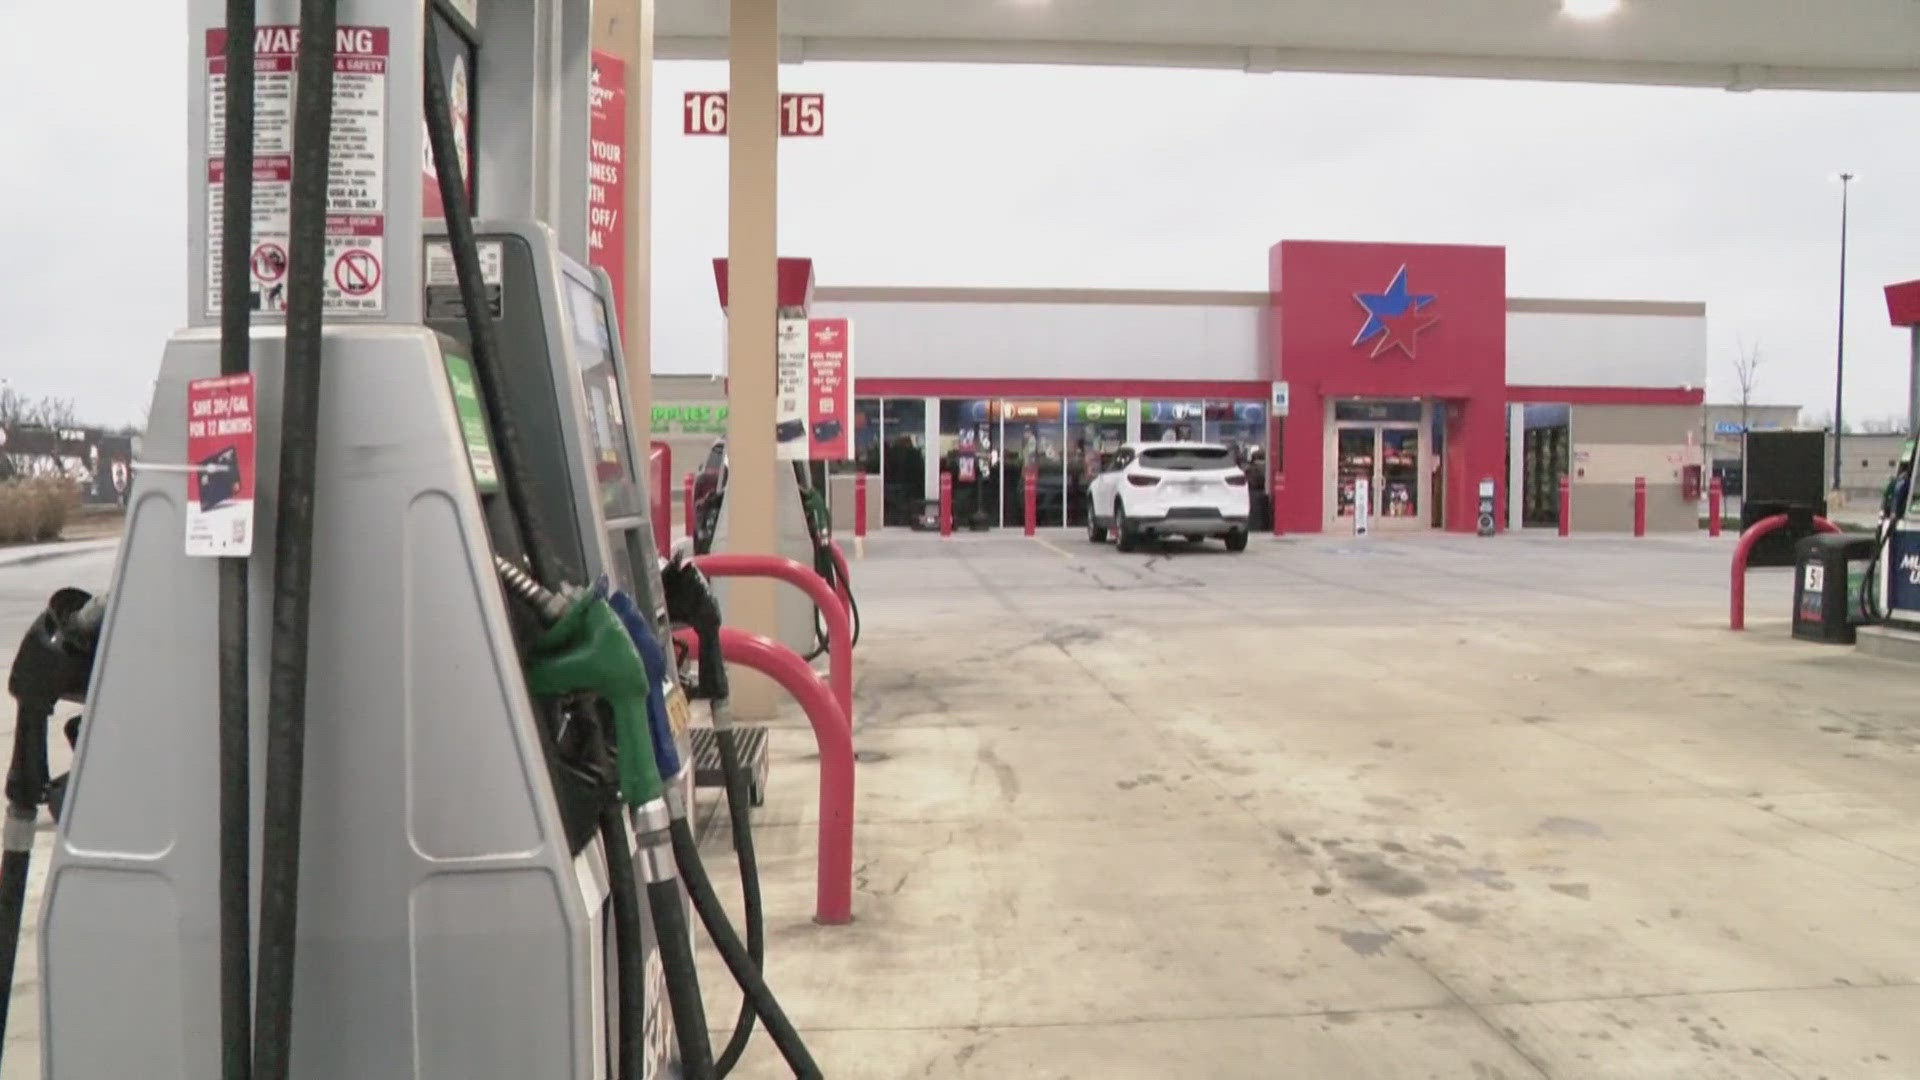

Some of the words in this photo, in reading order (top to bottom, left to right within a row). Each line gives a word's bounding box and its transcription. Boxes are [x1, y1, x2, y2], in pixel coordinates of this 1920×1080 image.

[346, 59, 383, 72] SAFETY
[686, 95, 725, 132] 16
[783, 97, 822, 134] 15
[591, 138, 621, 163] YOUR
[590, 228, 604, 250] AL
